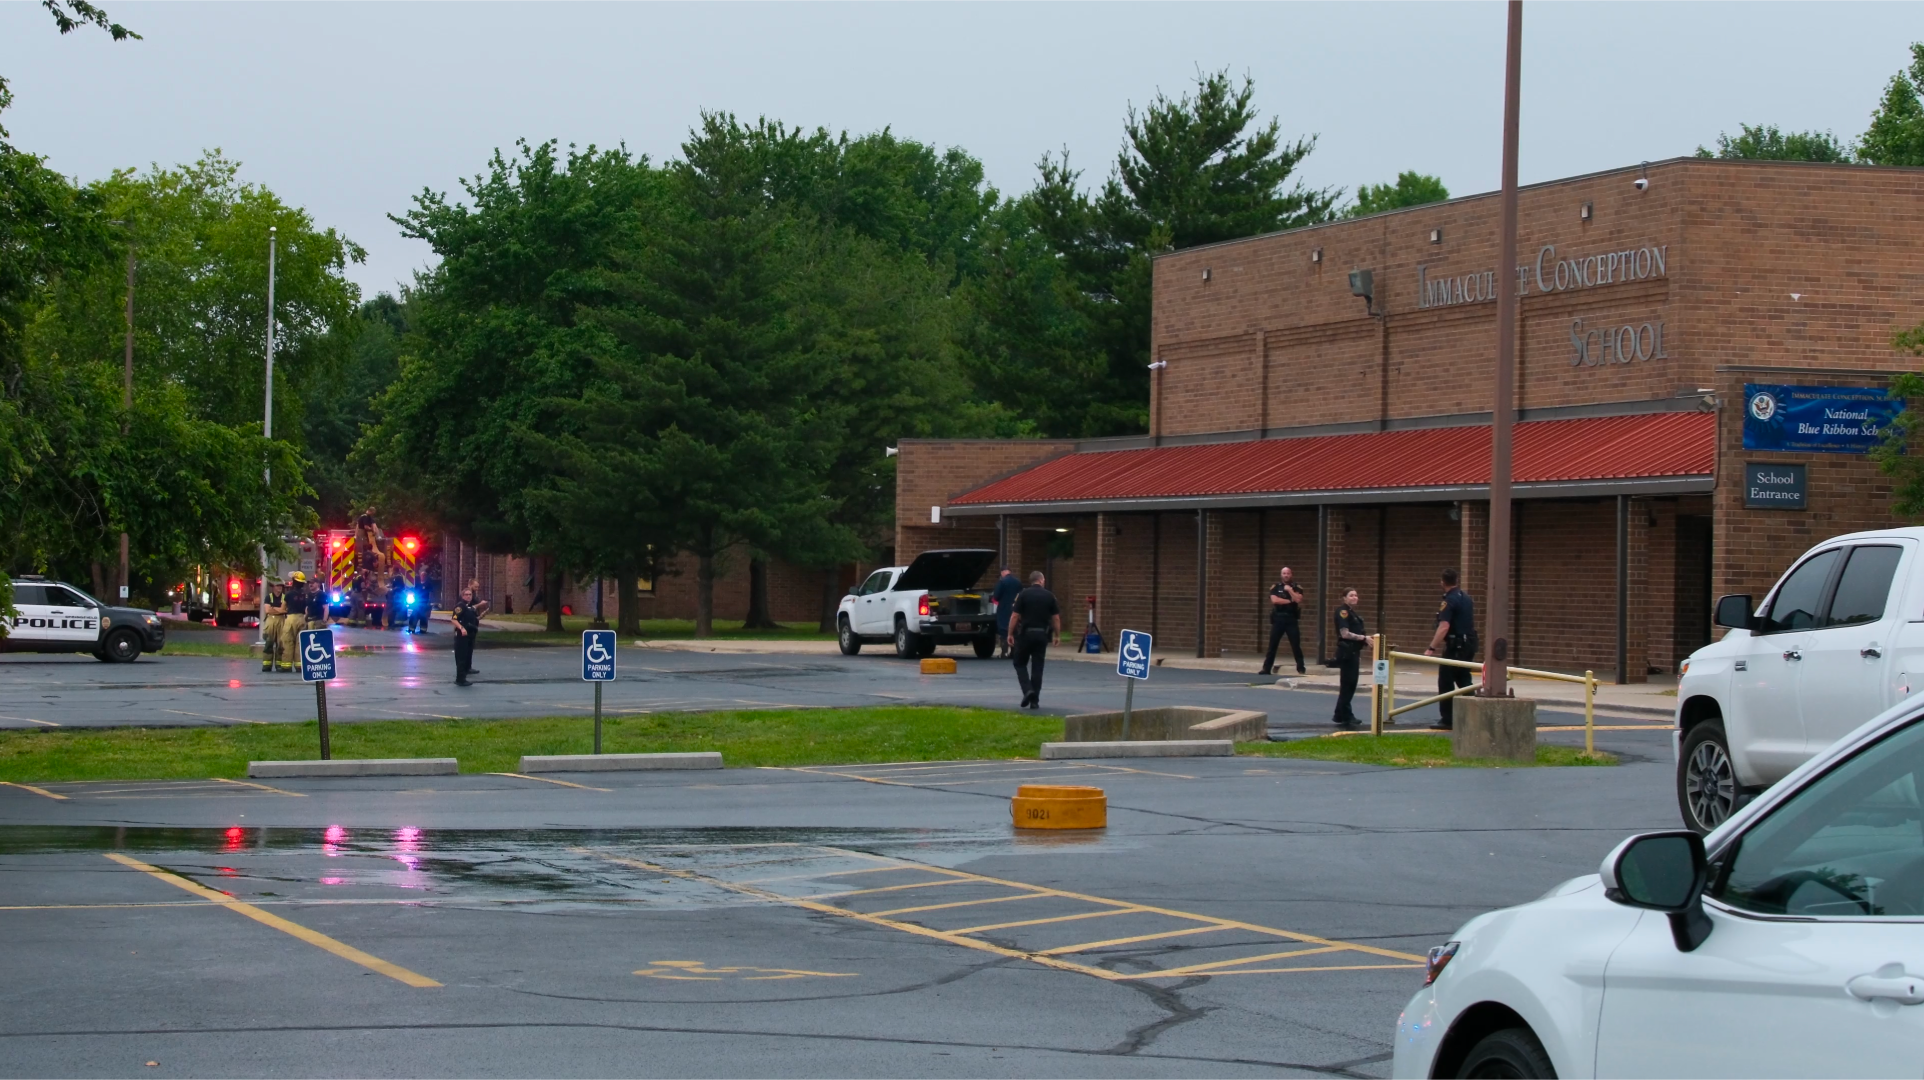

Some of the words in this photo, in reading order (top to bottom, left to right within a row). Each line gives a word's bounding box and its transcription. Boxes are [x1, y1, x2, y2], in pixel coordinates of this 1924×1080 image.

[1417, 264, 1529, 309] IMMACULE
[1536, 244, 1667, 293] CONCEPTION
[1569, 318, 1668, 367] SCHOOL
[1824, 408, 1869, 420] National
[1797, 423, 1820, 435] Blue
[1822, 423, 1859, 435] Ribbon
[1756, 472, 1794, 484] School
[1750, 487, 1800, 500] Entrance
[13, 618, 97, 629] POLICE
[307, 664, 332, 672] PARKING
[1122, 661, 1144, 670] PARKING
[312, 671, 328, 679] ONLY
